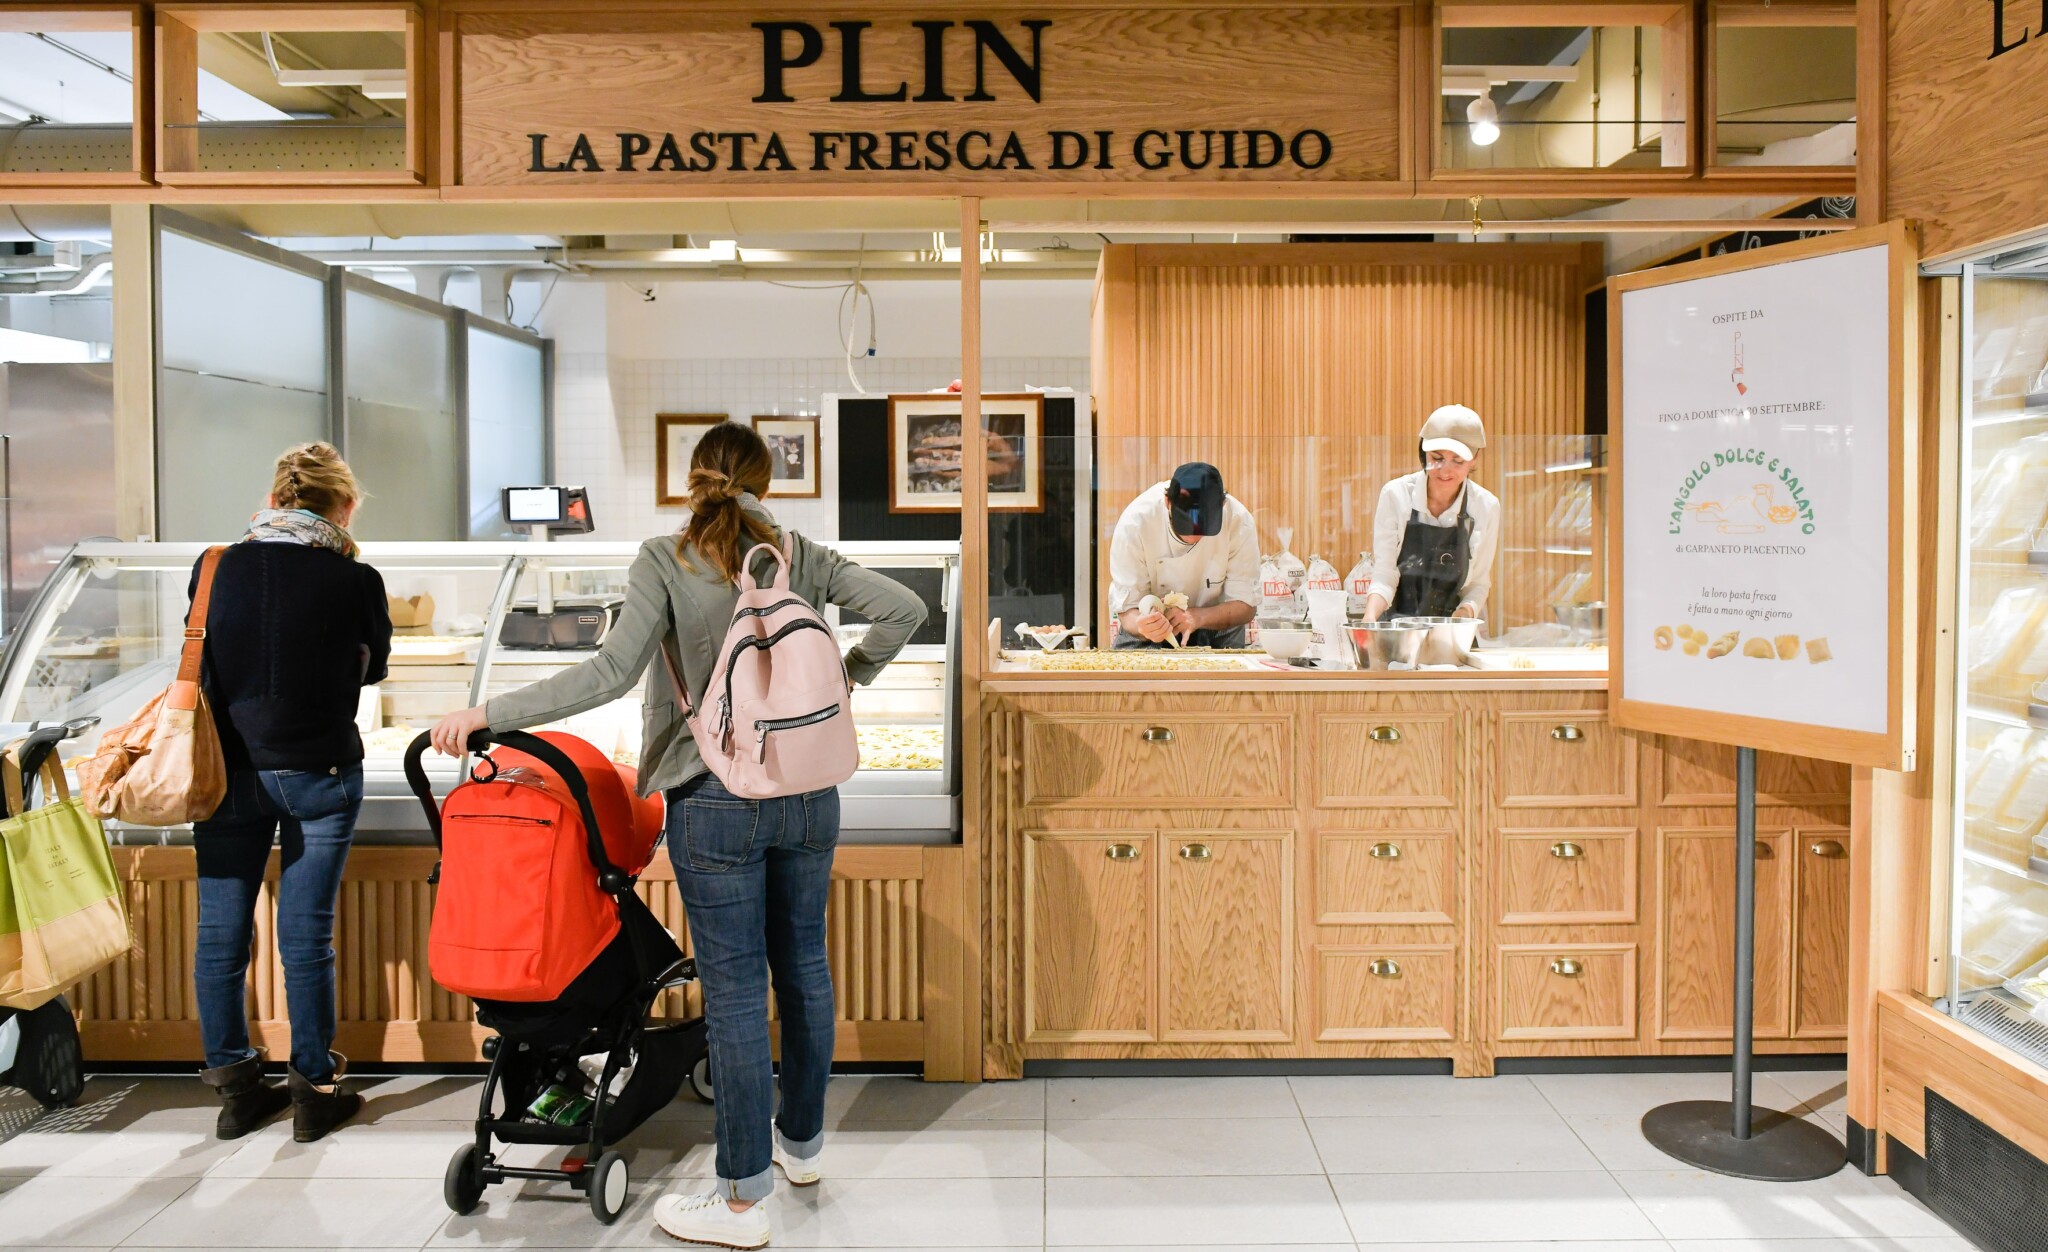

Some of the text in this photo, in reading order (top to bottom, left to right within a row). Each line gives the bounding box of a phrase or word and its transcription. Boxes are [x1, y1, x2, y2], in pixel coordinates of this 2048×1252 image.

[1986, 0, 2048, 60] L
[751, 18, 1053, 103] PLIN
[527, 128, 1333, 172] LA PASTA FRESCA DI GUIDO
[1712, 309, 1764, 325] OSPITE DA
[1658, 412, 1682, 423] FINO
[1682, 412, 1690, 421] A
[1691, 407, 1744, 421] DOMENICA
[1759, 400, 1826, 415] SETTEMBRE:
[1669, 460, 1711, 535] L'ANGOLO
[1713, 447, 1766, 467] DOLCE
[1778, 467, 1816, 535] SALATO
[1675, 544, 1806, 555] di CARPANETO PIACENTINO
[1701, 586, 1777, 604] la loro pasta fresca
[1692, 602, 1712, 617] fatta
[1713, 607, 1719, 615] a
[1720, 606, 1744, 616] mano
[1745, 607, 1764, 621] ogni
[1764, 608, 1793, 622] giorno
